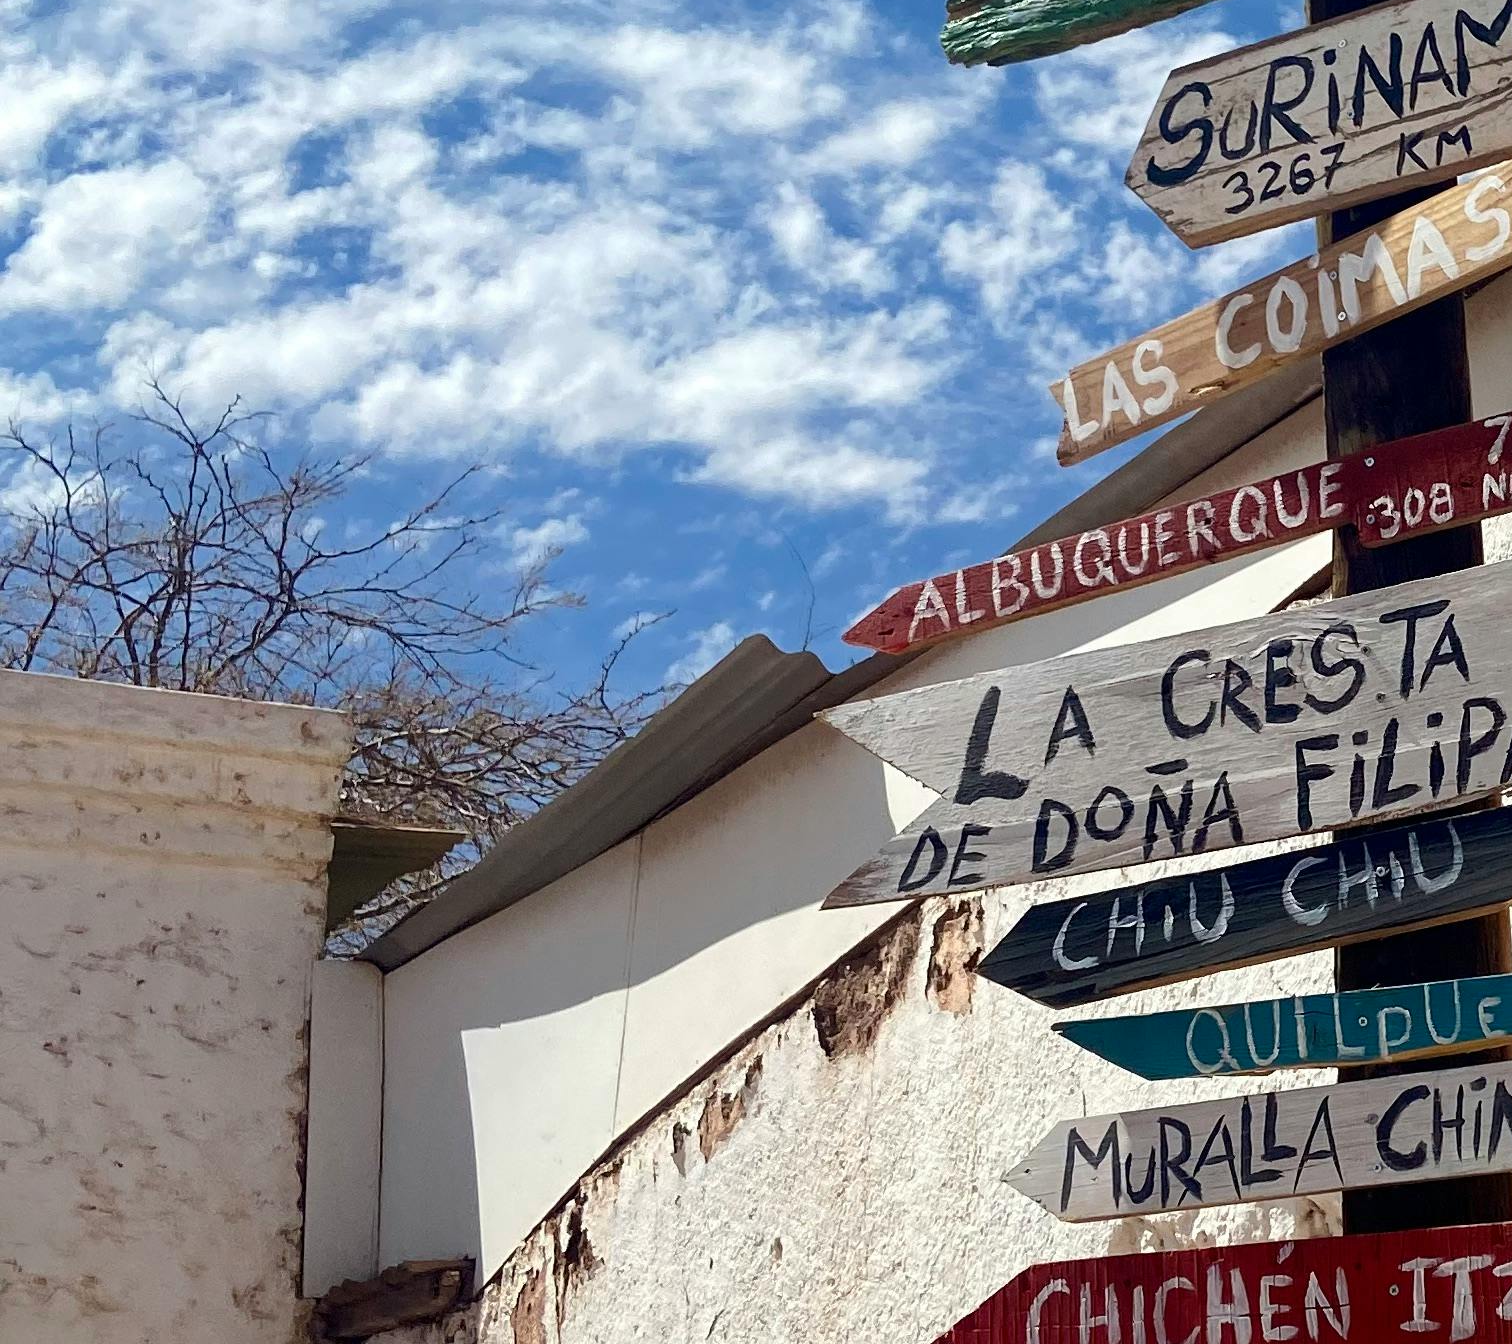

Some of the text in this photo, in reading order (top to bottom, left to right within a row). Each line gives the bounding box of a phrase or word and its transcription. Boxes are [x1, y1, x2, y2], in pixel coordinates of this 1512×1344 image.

[1222, 124, 1473, 215] 3267 KM
[1063, 339, 1180, 443] LAS
[907, 461, 1347, 644] ALBUQUERQUE
[1372, 482, 1455, 540] 308
[955, 598, 1471, 806] LA CRESTA
[897, 822, 993, 893] DE
[1031, 758, 1244, 874] DOÑA
[1185, 979, 1508, 1075] QUILPUE
